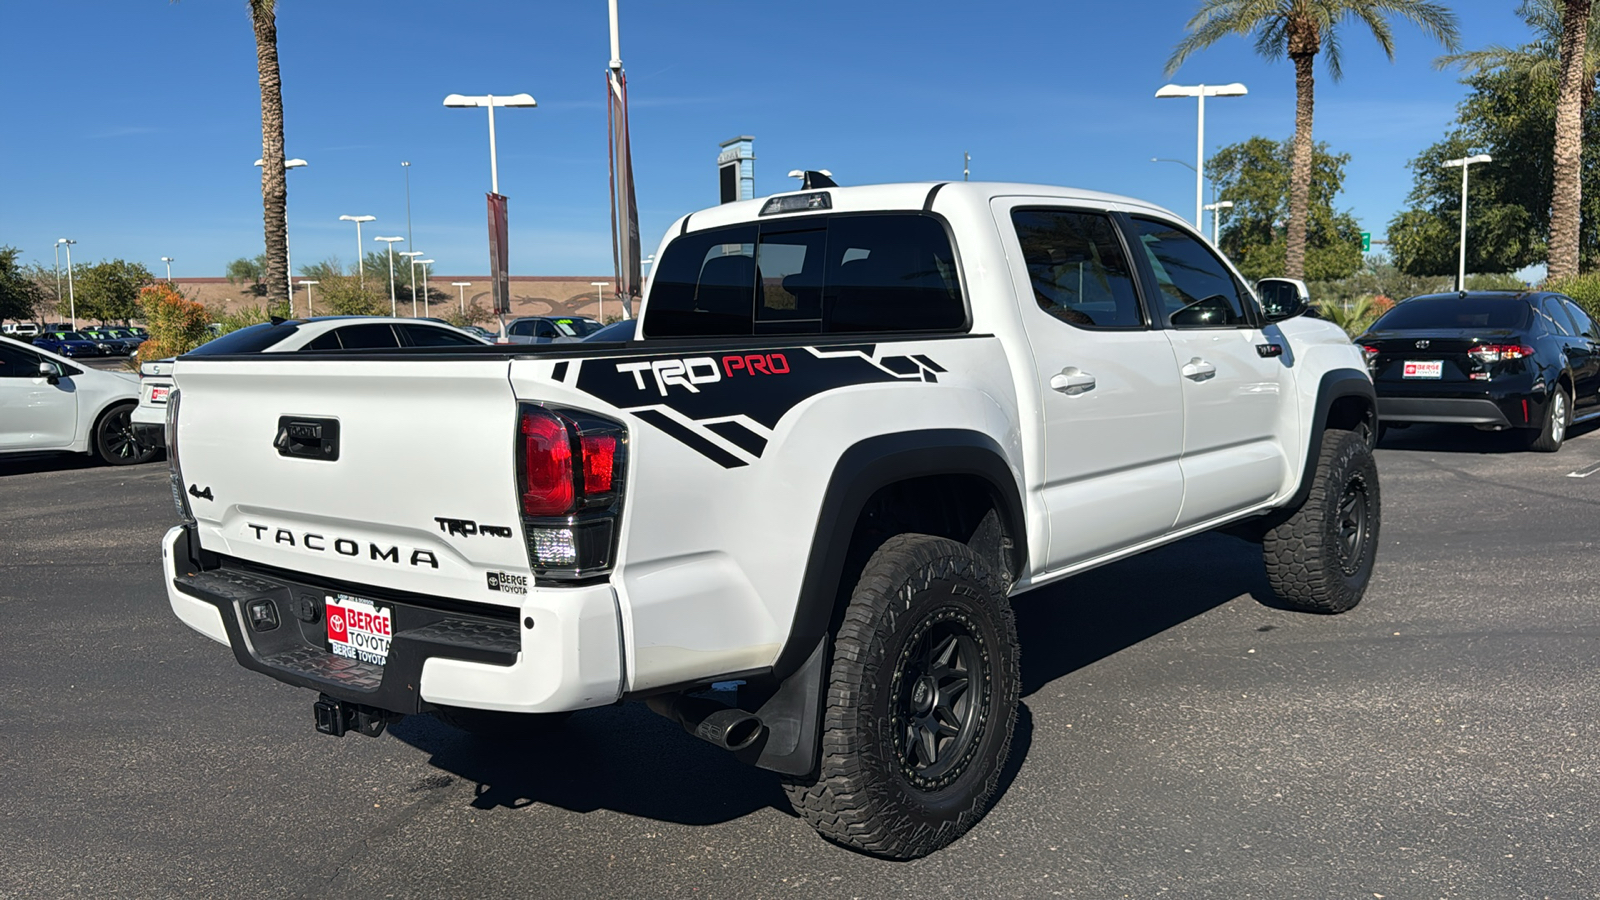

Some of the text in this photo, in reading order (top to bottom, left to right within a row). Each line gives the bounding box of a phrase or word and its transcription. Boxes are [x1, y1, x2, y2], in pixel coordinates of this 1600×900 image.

[616, 353, 790, 396] TRD PRO
[434, 517, 512, 538] TRD PRO
[247, 523, 439, 569] TACOMA
[499, 572, 528, 586] BERGE
[501, 585, 528, 595] TOYOTA
[347, 608, 390, 635] BERGE
[349, 631, 391, 653] TOYOTA
[333, 643, 387, 666] BERGE TOYOTA
